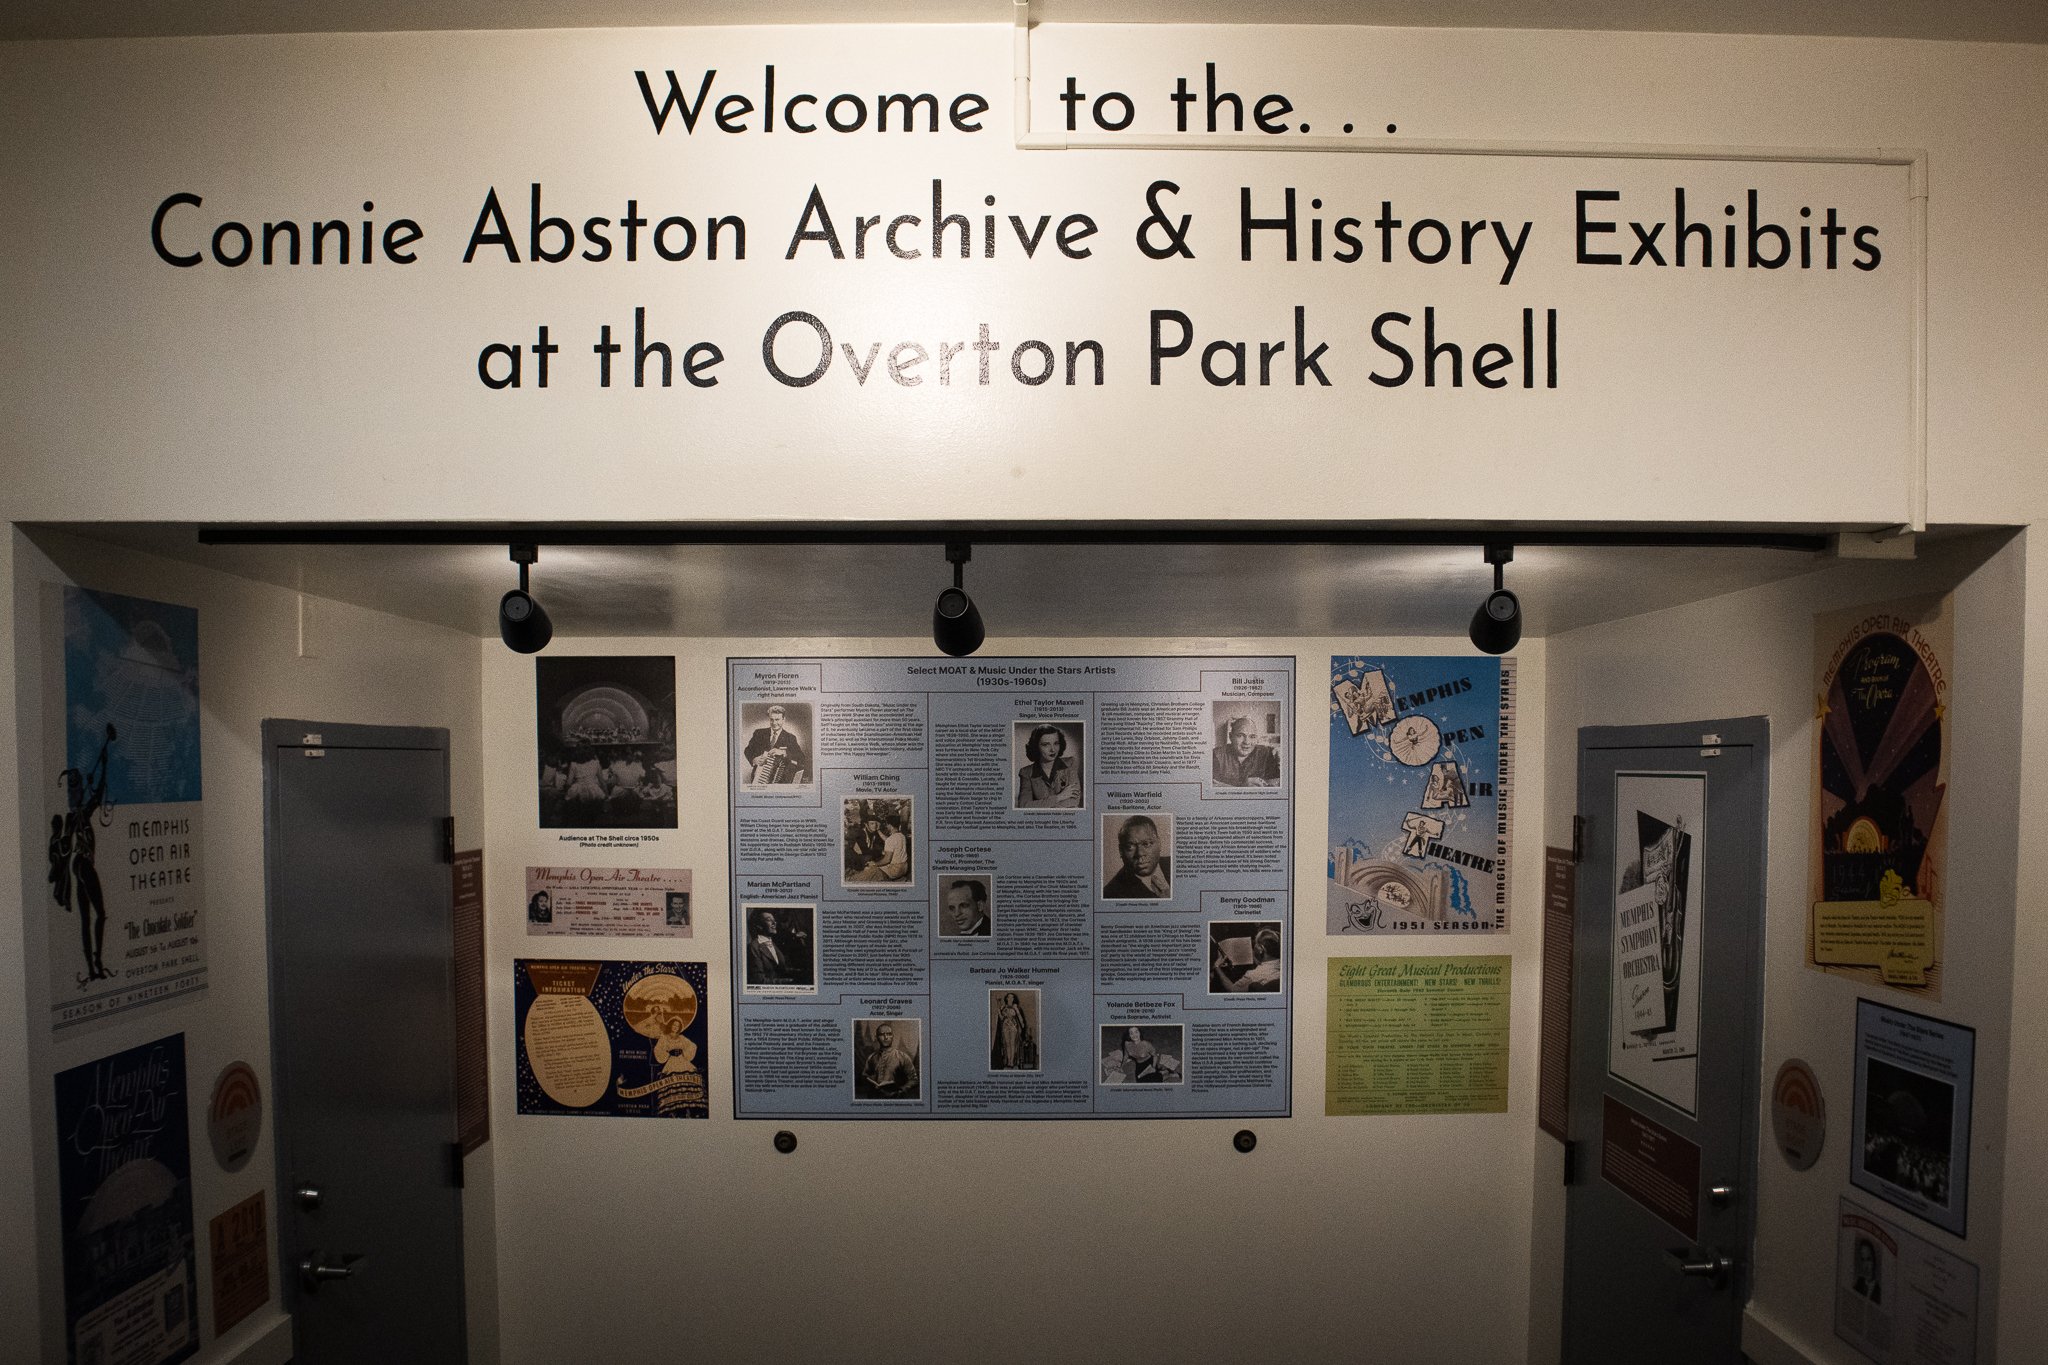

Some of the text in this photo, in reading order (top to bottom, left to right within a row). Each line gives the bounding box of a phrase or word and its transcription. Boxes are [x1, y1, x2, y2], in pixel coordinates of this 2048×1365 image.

[636, 66, 990, 136] Welcome
[1061, 78, 1136, 133] to
[152, 180, 1884, 286] Connie Abston Archive & History Exhibits
[479, 307, 1558, 390] at the Overton Park Shell
[1824, 615, 1947, 695] MEMPHIS OPEN AIR THEATRE
[754, 672, 776, 680] Myron
[907, 666, 1116, 675] Select MOAT & Music Under the Stars Artists
[976, 678, 1047, 687] (1930s-1960s)
[880, 774, 900, 782] Ching
[1496, 670, 1510, 930] THE MAGIC OF MUSIC UNDER THE STARS
[129, 818, 189, 838] MEMPHIS
[130, 843, 190, 865] OPEN AIR
[938, 846, 963, 854] Joseph
[130, 866, 190, 890] THEATRE
[534, 868, 576, 884] Memphis
[580, 867, 604, 884] Open
[604, 868, 626, 883] Air
[1220, 896, 1241, 904] Benny
[1393, 922, 1492, 931] 1951 SEASON
[1620, 901, 1654, 929] MEMPHIS
[1621, 925, 1658, 954] SYMPHONY
[126, 953, 200, 978] OVERTON PARK SHELL
[643, 964, 655, 976] the
[1339, 962, 1503, 979] Eight Great Musical Productions
[1623, 954, 1660, 979] ORCHESTRA
[62, 976, 200, 1019] SEASON OF NINETEEN FORTY
[620, 1073, 700, 1097] MEMPHIS OPEN AIR THEATRE
